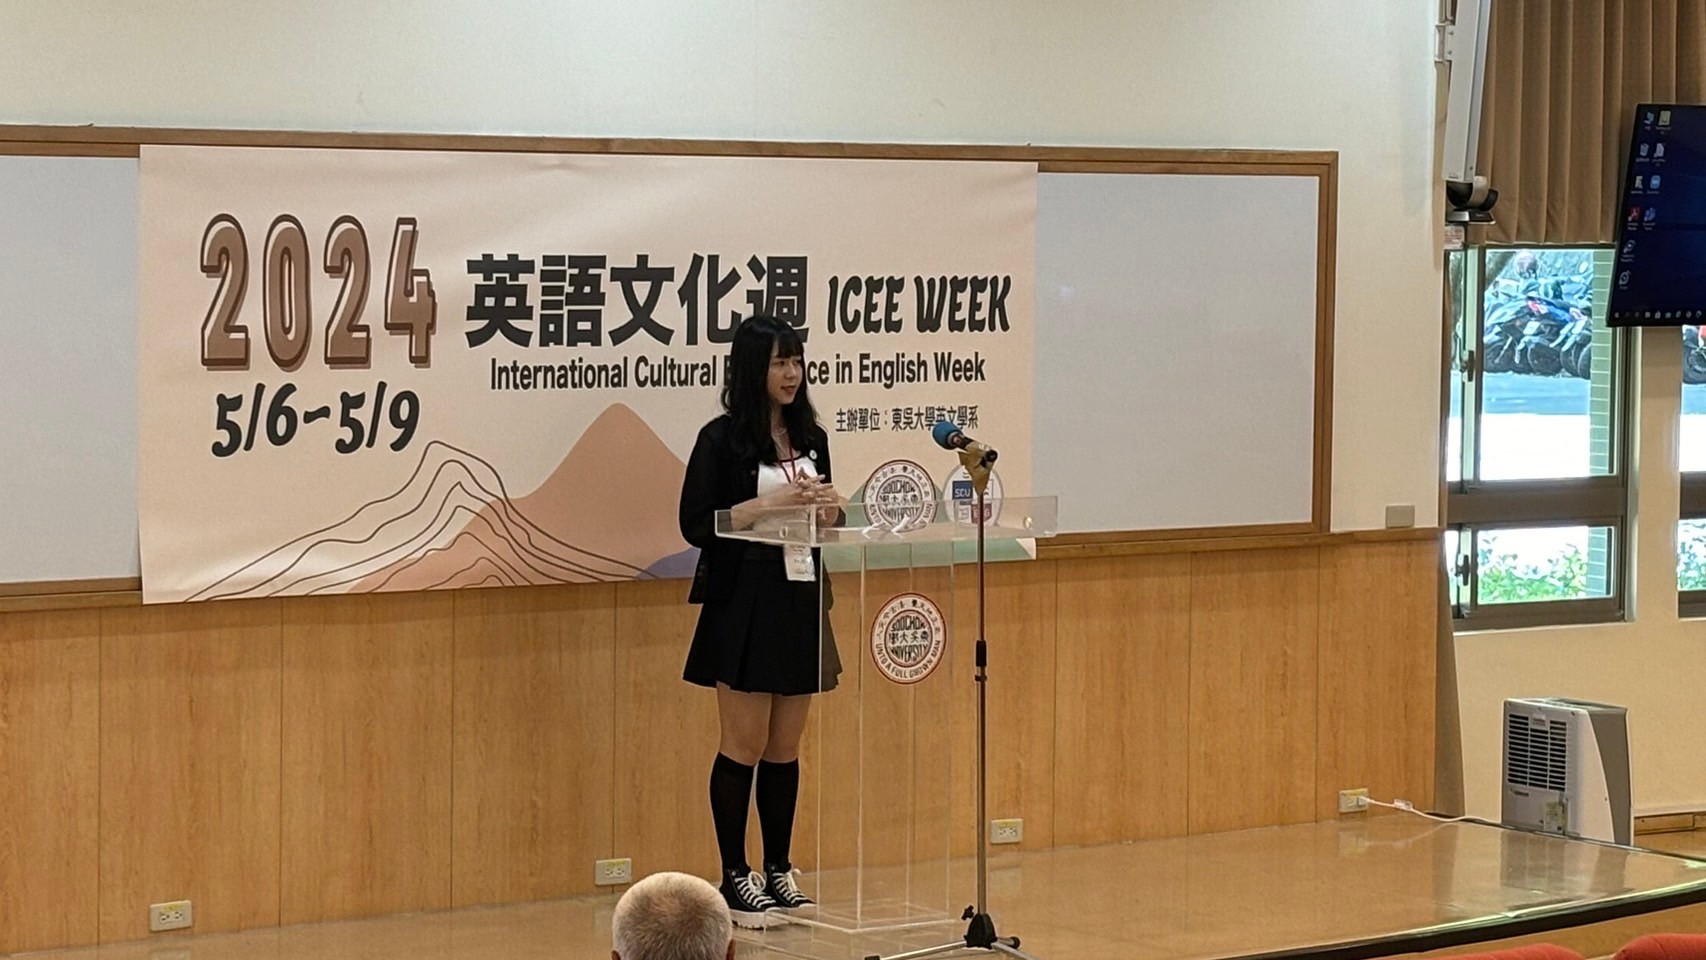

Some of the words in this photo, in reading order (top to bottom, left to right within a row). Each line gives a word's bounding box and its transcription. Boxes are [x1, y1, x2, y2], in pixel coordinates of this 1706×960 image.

[200, 213, 437, 372] 2024
[465, 253, 809, 347] 英語文化週
[827, 275, 904, 334] ICEE
[914, 275, 1011, 333] WEEK
[490, 356, 628, 390] International
[635, 355, 717, 388] Cultural
[836, 353, 852, 384] in
[859, 351, 928, 389] English
[934, 351, 986, 382] Week
